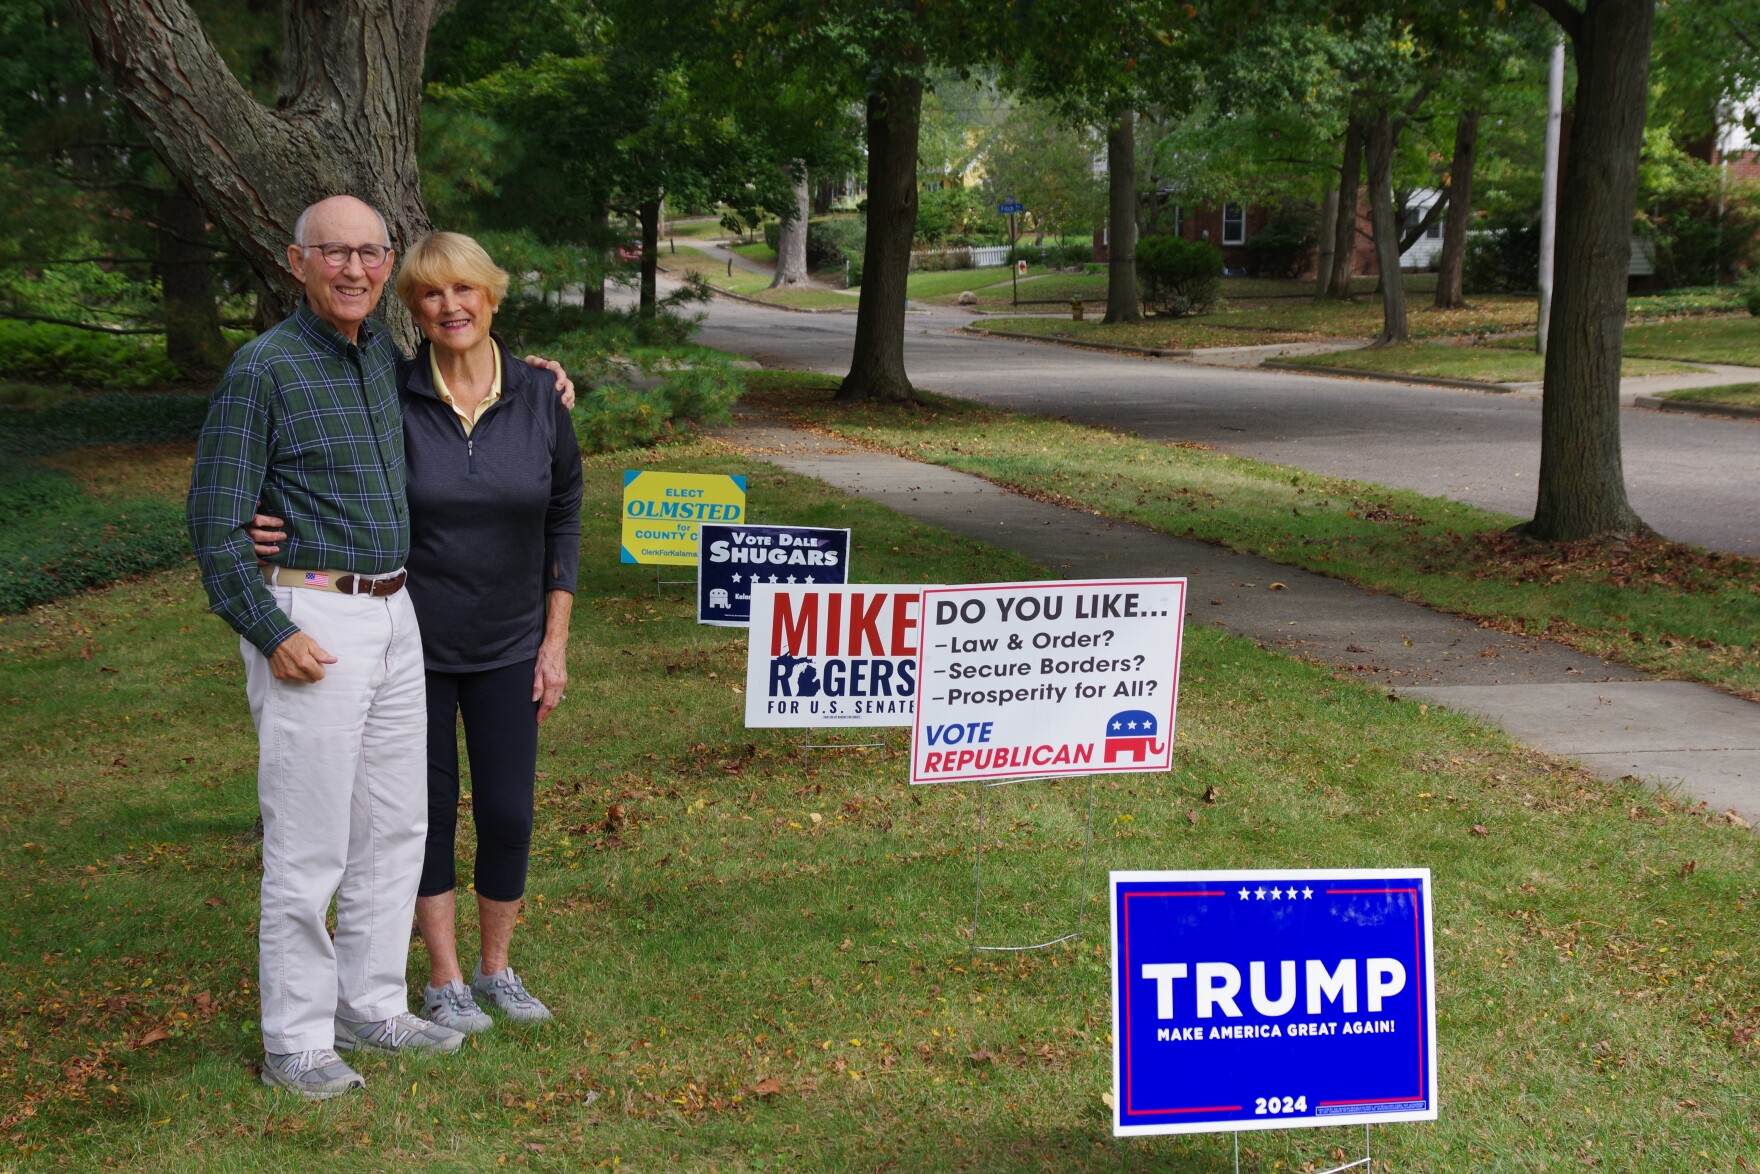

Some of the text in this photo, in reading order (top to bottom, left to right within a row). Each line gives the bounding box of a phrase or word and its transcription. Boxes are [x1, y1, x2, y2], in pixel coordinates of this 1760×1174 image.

[665, 488, 704, 498] ELECT
[627, 500, 741, 520] OLMSTED
[635, 530, 686, 540] COUNTY
[677, 523, 691, 531] for
[936, 593, 1168, 625] DO YOU LIKE...
[770, 592, 920, 657] MIKE
[1007, 633, 1023, 651] &
[1032, 630, 1115, 649] Order?
[1040, 655, 1145, 675] Borders?
[1075, 682, 1106, 698] for
[1113, 680, 1158, 697] All?
[768, 700, 914, 714] FOR U.S. SENATE
[926, 722, 993, 746] VOTE
[924, 743, 1094, 773] REPUBLICAN
[1142, 958, 1406, 1019] TRUMP
[1157, 1020, 1395, 1042] MAKE AMERICA GREAT AGAIN!
[1255, 1096, 1307, 1115] 2024
